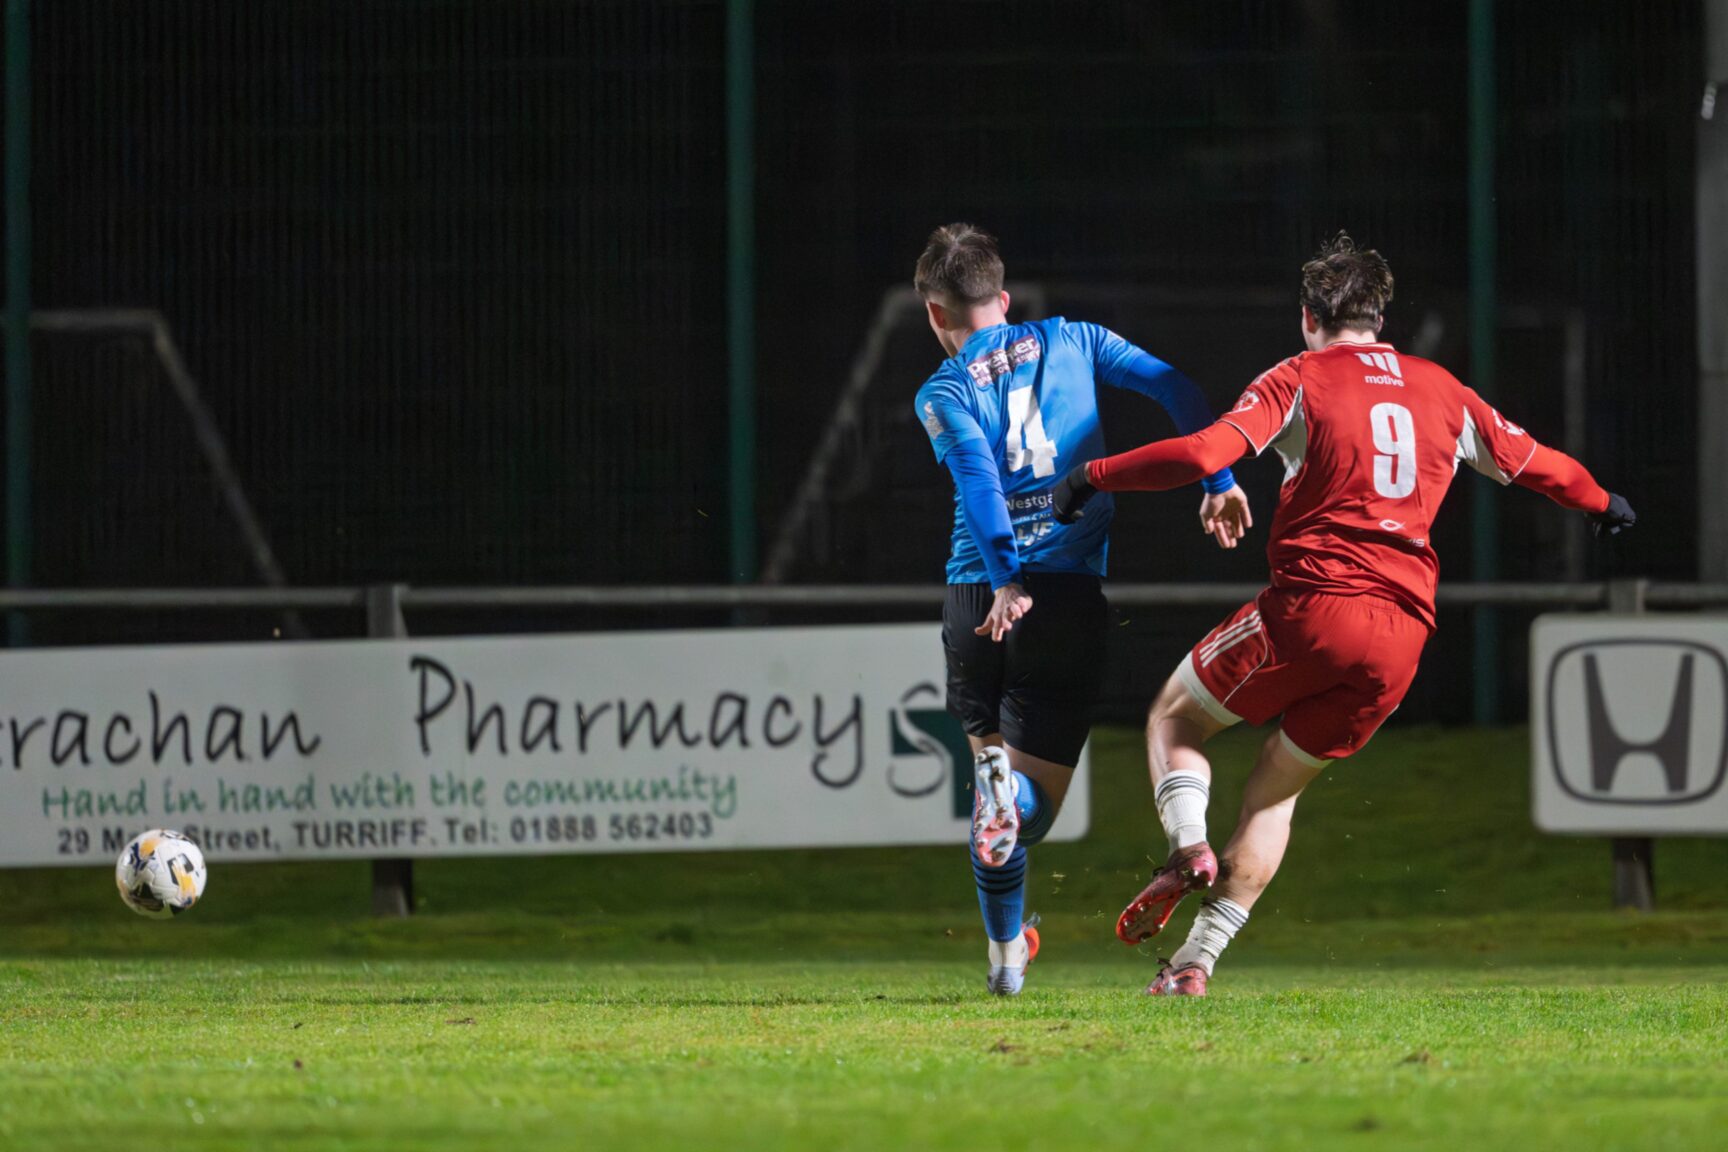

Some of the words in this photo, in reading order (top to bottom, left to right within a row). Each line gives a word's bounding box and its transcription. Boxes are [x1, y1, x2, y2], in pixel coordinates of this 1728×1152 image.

[1364, 375, 1405, 387] motive
[1006, 385, 1058, 479] 4
[1369, 402, 1417, 499] 9
[0, 690, 321, 769] rachan
[410, 656, 864, 789] Pharmacy
[41, 778, 147, 818] Hand
[163, 776, 205, 814] in
[217, 774, 316, 812] hand
[330, 771, 415, 808] with
[429, 771, 486, 807] the
[504, 764, 737, 818] community
[58, 828, 89, 855] 29
[443, 817, 499, 844] Tel:
[510, 814, 597, 842] 01888
[608, 811, 713, 840] 562403
